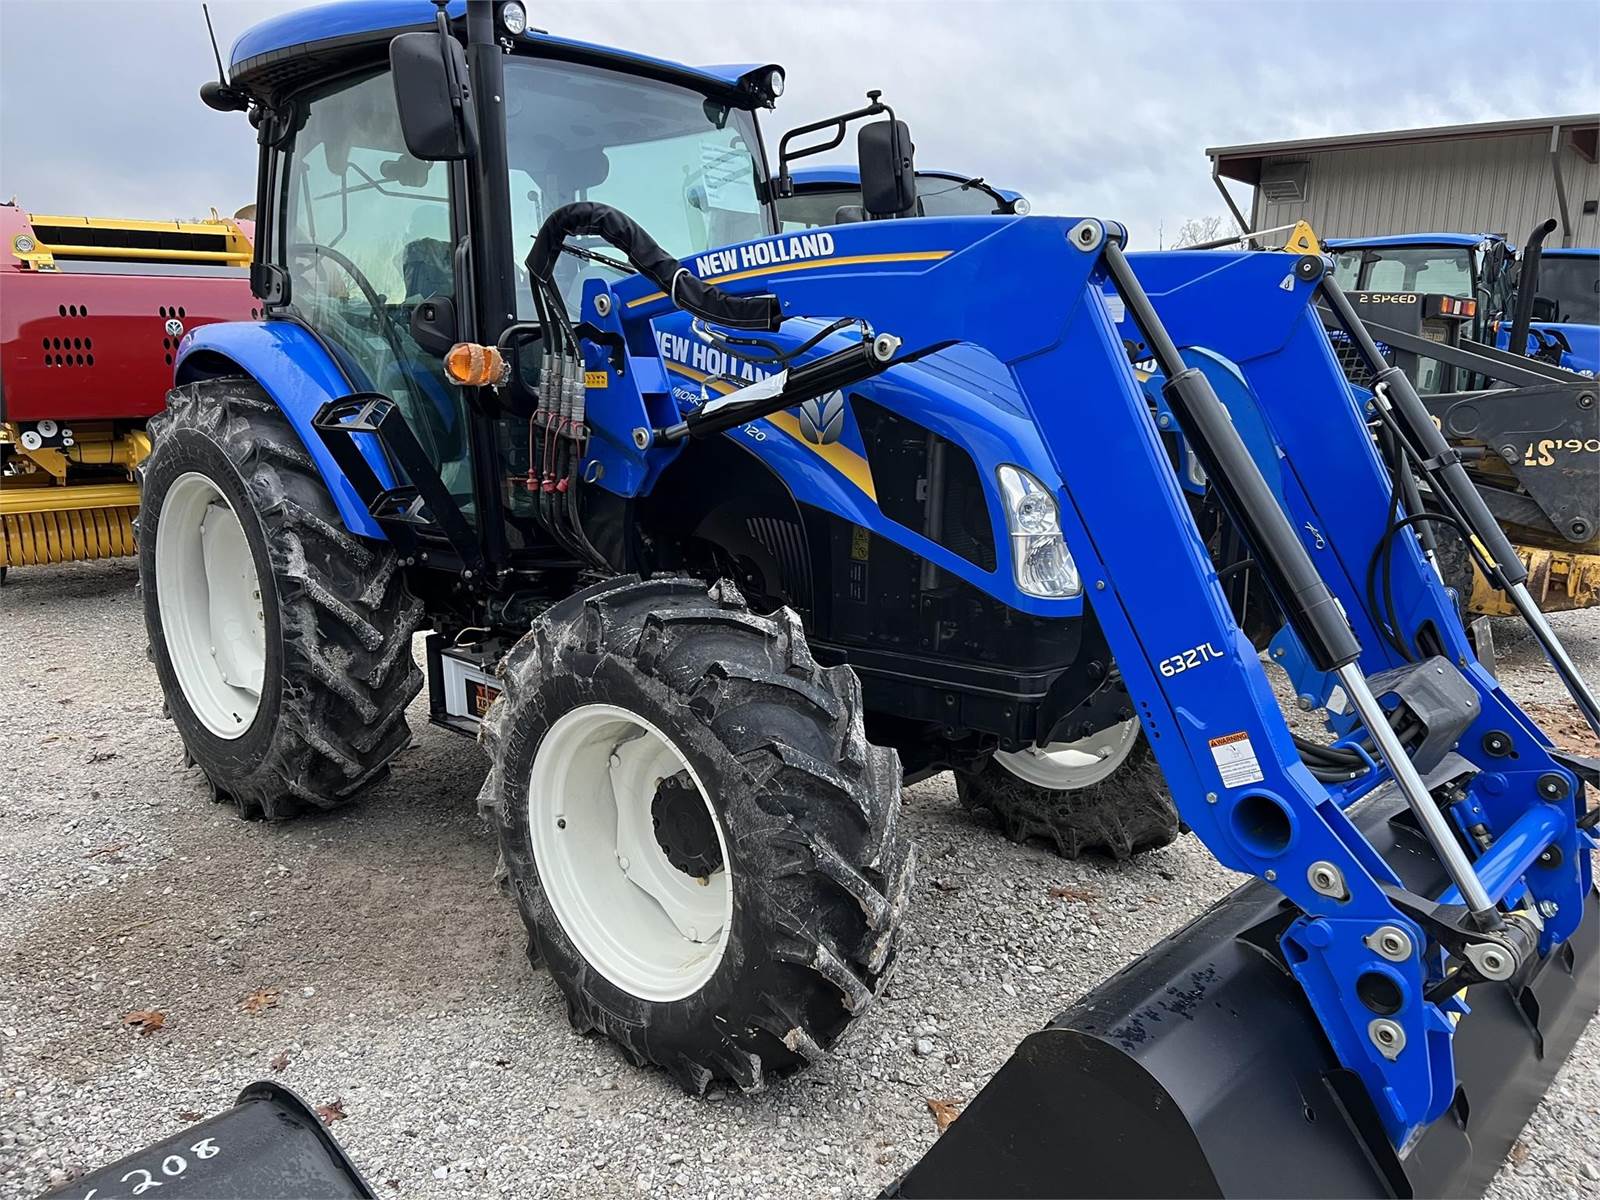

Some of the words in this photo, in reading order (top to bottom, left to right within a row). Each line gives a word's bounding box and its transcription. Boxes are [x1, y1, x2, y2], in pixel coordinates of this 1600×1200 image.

[695, 248, 738, 278] NEW
[740, 232, 835, 268] HOLLAND
[1359, 294, 1369, 303] 2
[1372, 294, 1417, 304] SPEED
[744, 424, 767, 441] 120
[1159, 642, 1224, 677] 632TL
[1216, 732, 1248, 746] WARNING
